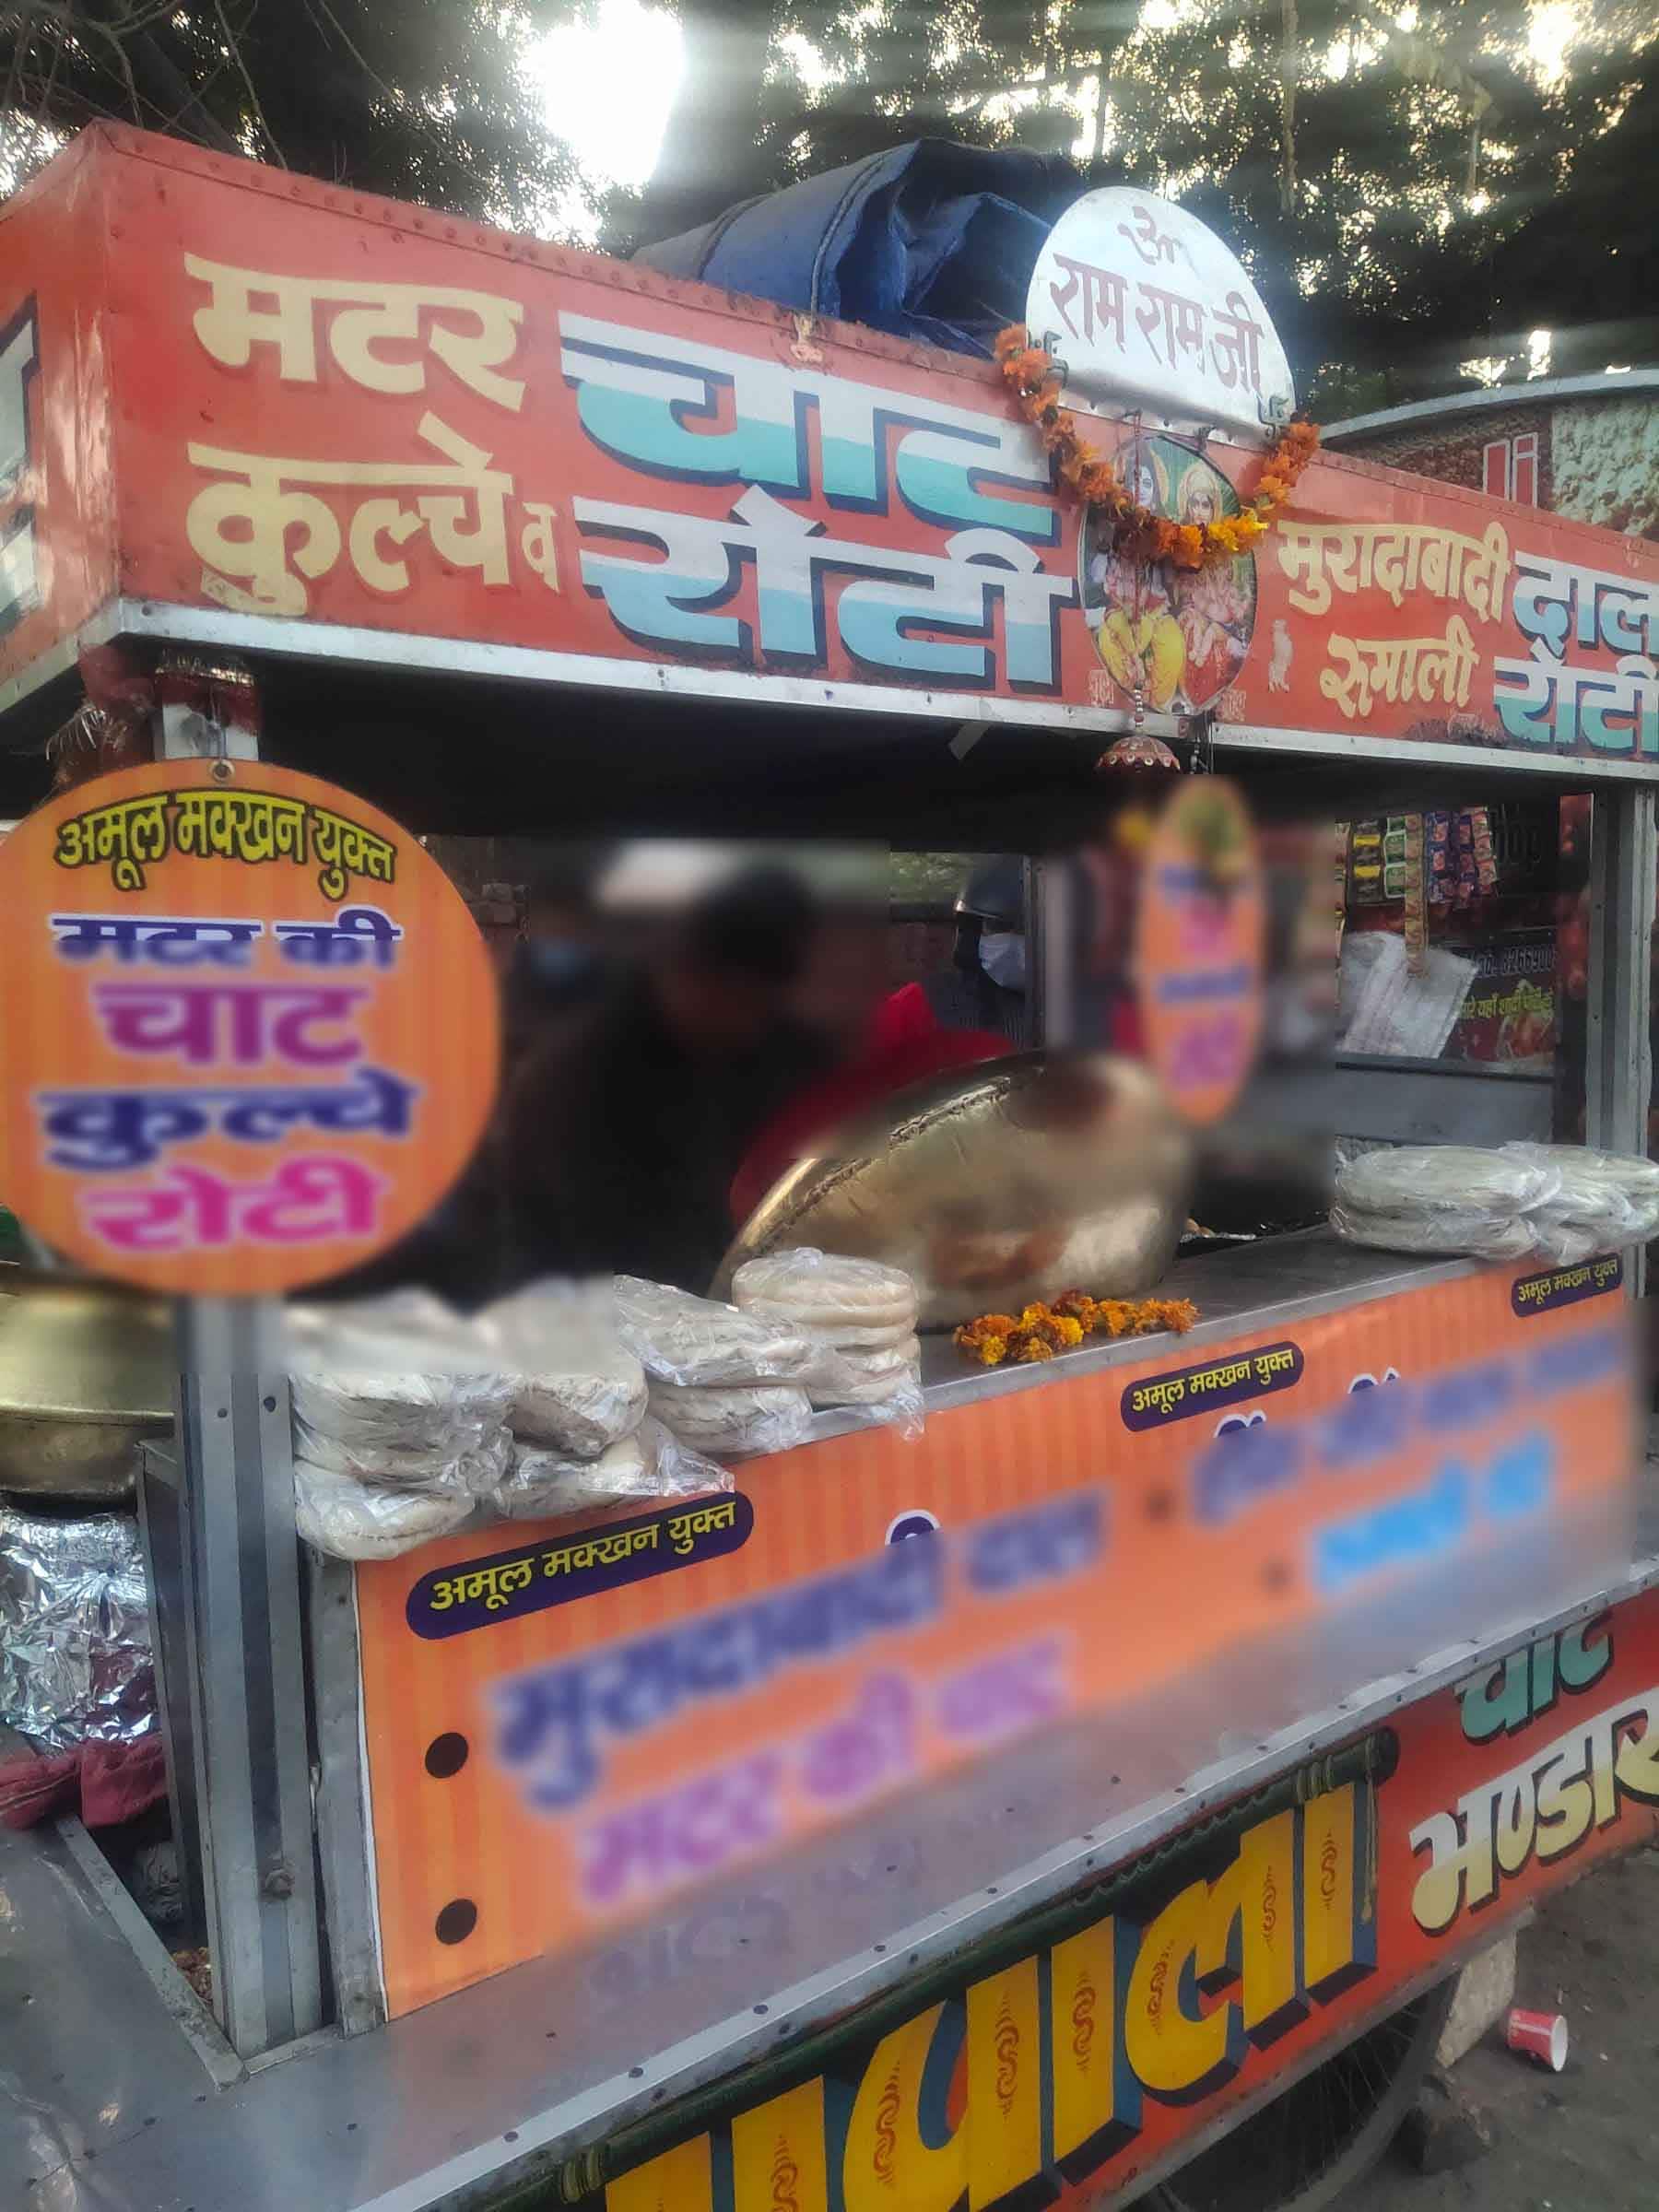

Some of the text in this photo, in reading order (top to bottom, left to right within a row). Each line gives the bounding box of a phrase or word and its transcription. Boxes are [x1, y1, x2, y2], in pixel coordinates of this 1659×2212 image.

[183, 252, 526, 413] मटर
[558, 310, 1062, 547] चाट
[521, 500, 560, 594] व
[572, 484, 1083, 698] रोटी
[1277, 520, 1512, 624] मुरादाबादी
[53, 787, 398, 901] अमूल मक्खन युक्त
[50, 903, 406, 971] मटर की
[1517, 1278, 1552, 1305] अमूल
[1132, 1348, 1295, 1414] अमूल मक्खन युक्त
[429, 1500, 736, 1610] अमूल मक्खन युक्त
